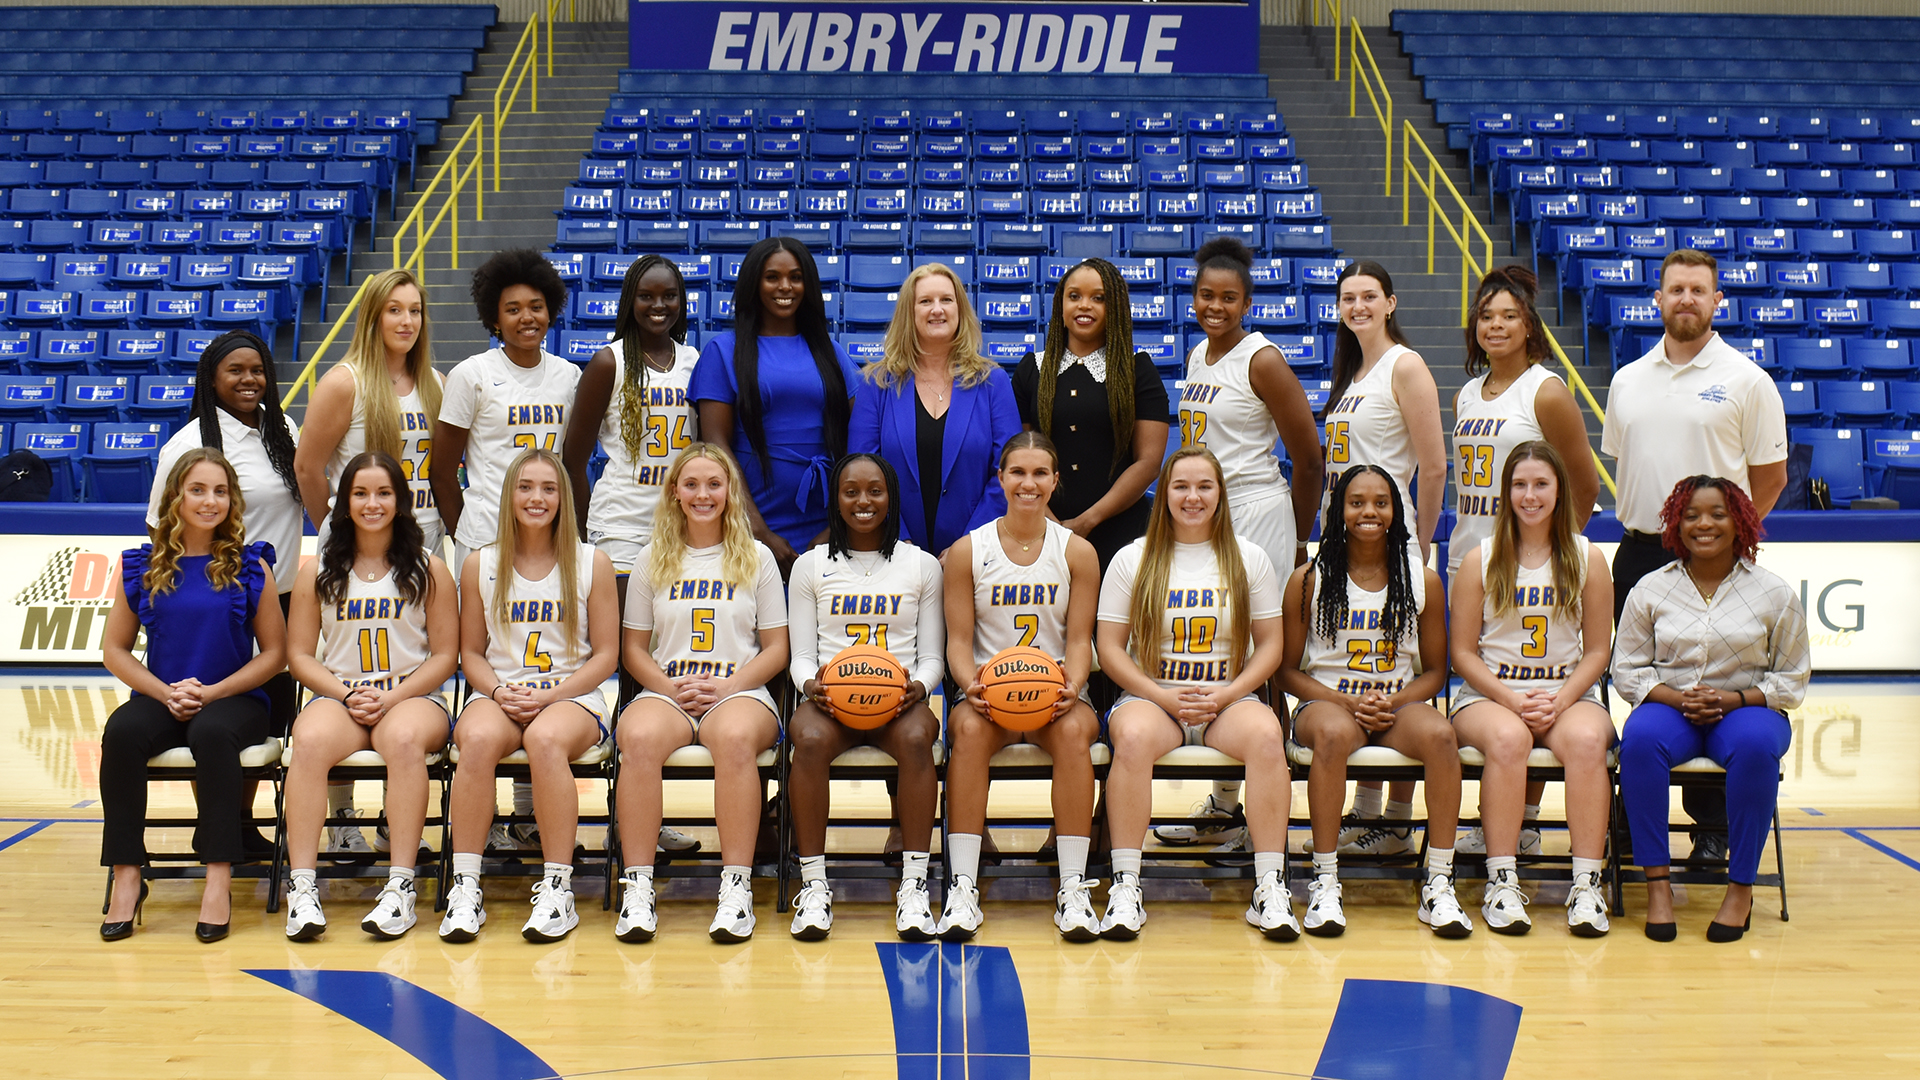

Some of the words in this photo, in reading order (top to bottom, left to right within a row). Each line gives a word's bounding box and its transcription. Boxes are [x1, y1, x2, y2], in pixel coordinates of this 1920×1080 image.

[709, 11, 1182, 74] EMBRY-RIDDLE
[640, 387, 694, 408] EMBR
[1329, 395, 1366, 415] BRY
[507, 404, 565, 426] EMBRY
[645, 415, 693, 457] 34
[1180, 409, 1208, 449] 32
[1453, 418, 1508, 438] EMBRY
[1458, 444, 1495, 488] 33
[669, 579, 739, 601] EMBRY
[990, 583, 1060, 606] EMBRY
[1166, 588, 1229, 609] MBRY
[1515, 585, 1556, 608] MBR
[337, 597, 408, 621] EMBRY
[830, 593, 903, 616] EMBRY
[690, 608, 715, 652] 5
[1014, 614, 1040, 650] 2
[1171, 616, 1217, 654] 10
[1521, 615, 1548, 658] 3
[358, 628, 391, 673] 11
[523, 631, 553, 673] 4
[1347, 638, 1399, 673] 23
[667, 660, 737, 679] RIDDLE
[838, 661, 893, 679] Wilson
[993, 659, 1050, 678] Wilson
[1160, 659, 1228, 681] RIDDLE
[1497, 662, 1567, 680] RIDDLE
[1336, 677, 1404, 695] RIDDLE
